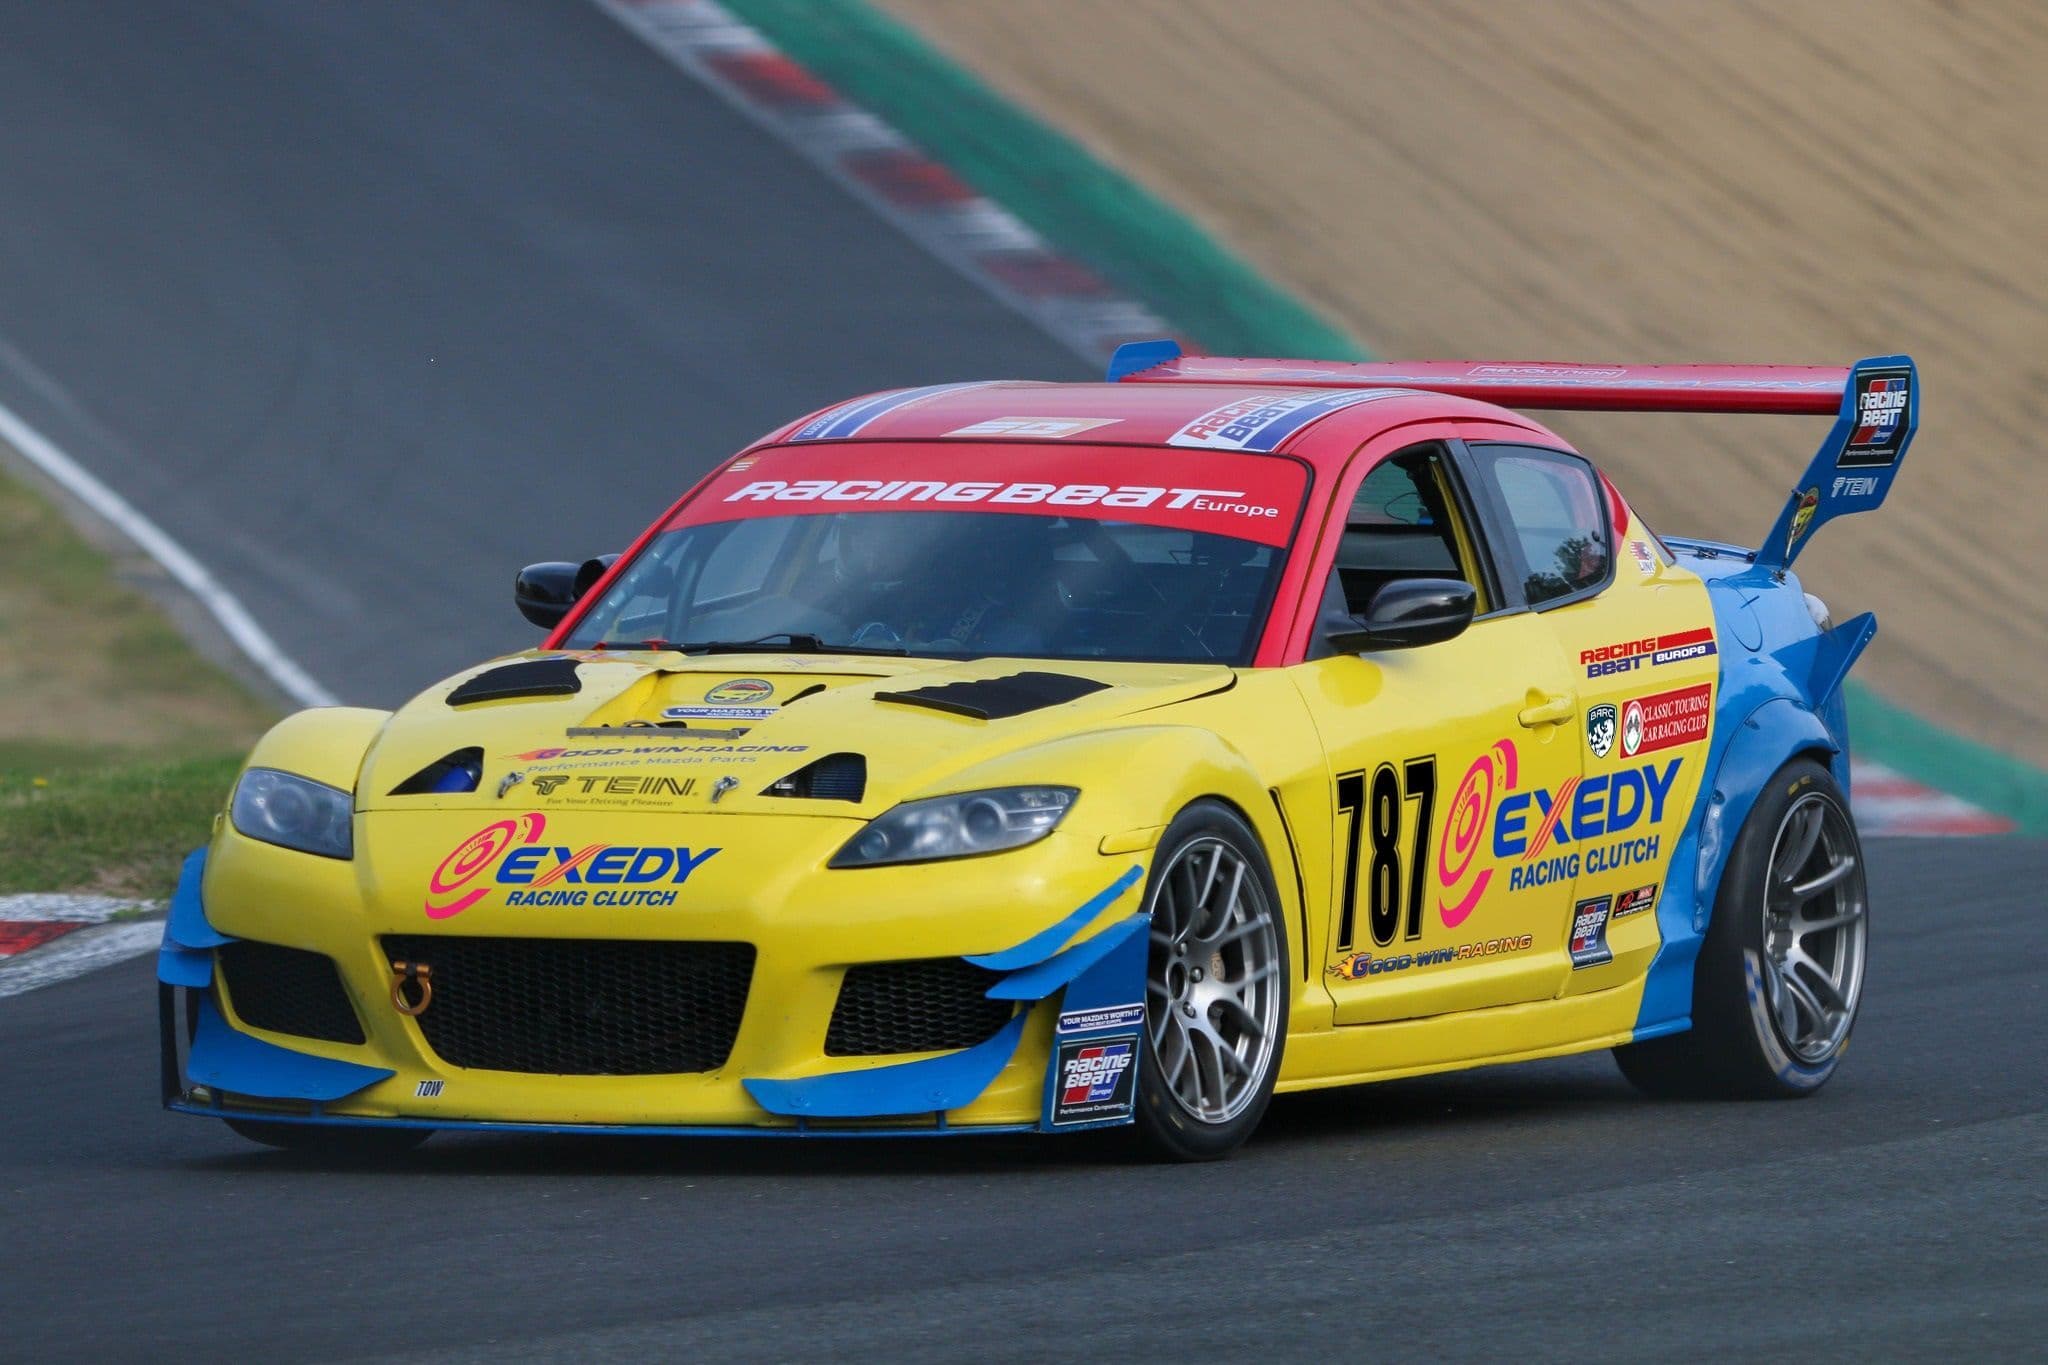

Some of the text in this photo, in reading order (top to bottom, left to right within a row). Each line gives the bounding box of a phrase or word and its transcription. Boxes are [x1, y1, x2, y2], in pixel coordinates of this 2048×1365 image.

[1842, 477, 1879, 496] TEIN
[1192, 498, 1279, 519] Europe
[1590, 707, 1614, 721] BARC
[1643, 693, 1709, 722] CLASSIC TOURING
[1642, 714, 1707, 743] CAR RACING CLUB
[537, 745, 809, 760] GOOD-WIN-RACING
[526, 755, 757, 773] Performance Mazda Parts
[577, 776, 697, 797] TEIN
[547, 797, 673, 807] For Your Driving Pleasure
[1493, 757, 1684, 861] EXEDY
[1335, 753, 1438, 952] 787
[495, 843, 724, 889] EXEDY
[1509, 834, 1660, 892] RACING CLUTCH
[505, 890, 679, 906] RACING CLUTCH
[1351, 934, 1533, 978] GOOD-WIN-RACING
[1063, 1009, 1141, 1026] YOUR MAZDA'S WORTH IT
[417, 1080, 444, 1097] TOW
[1060, 1106, 1093, 1115] Performance
